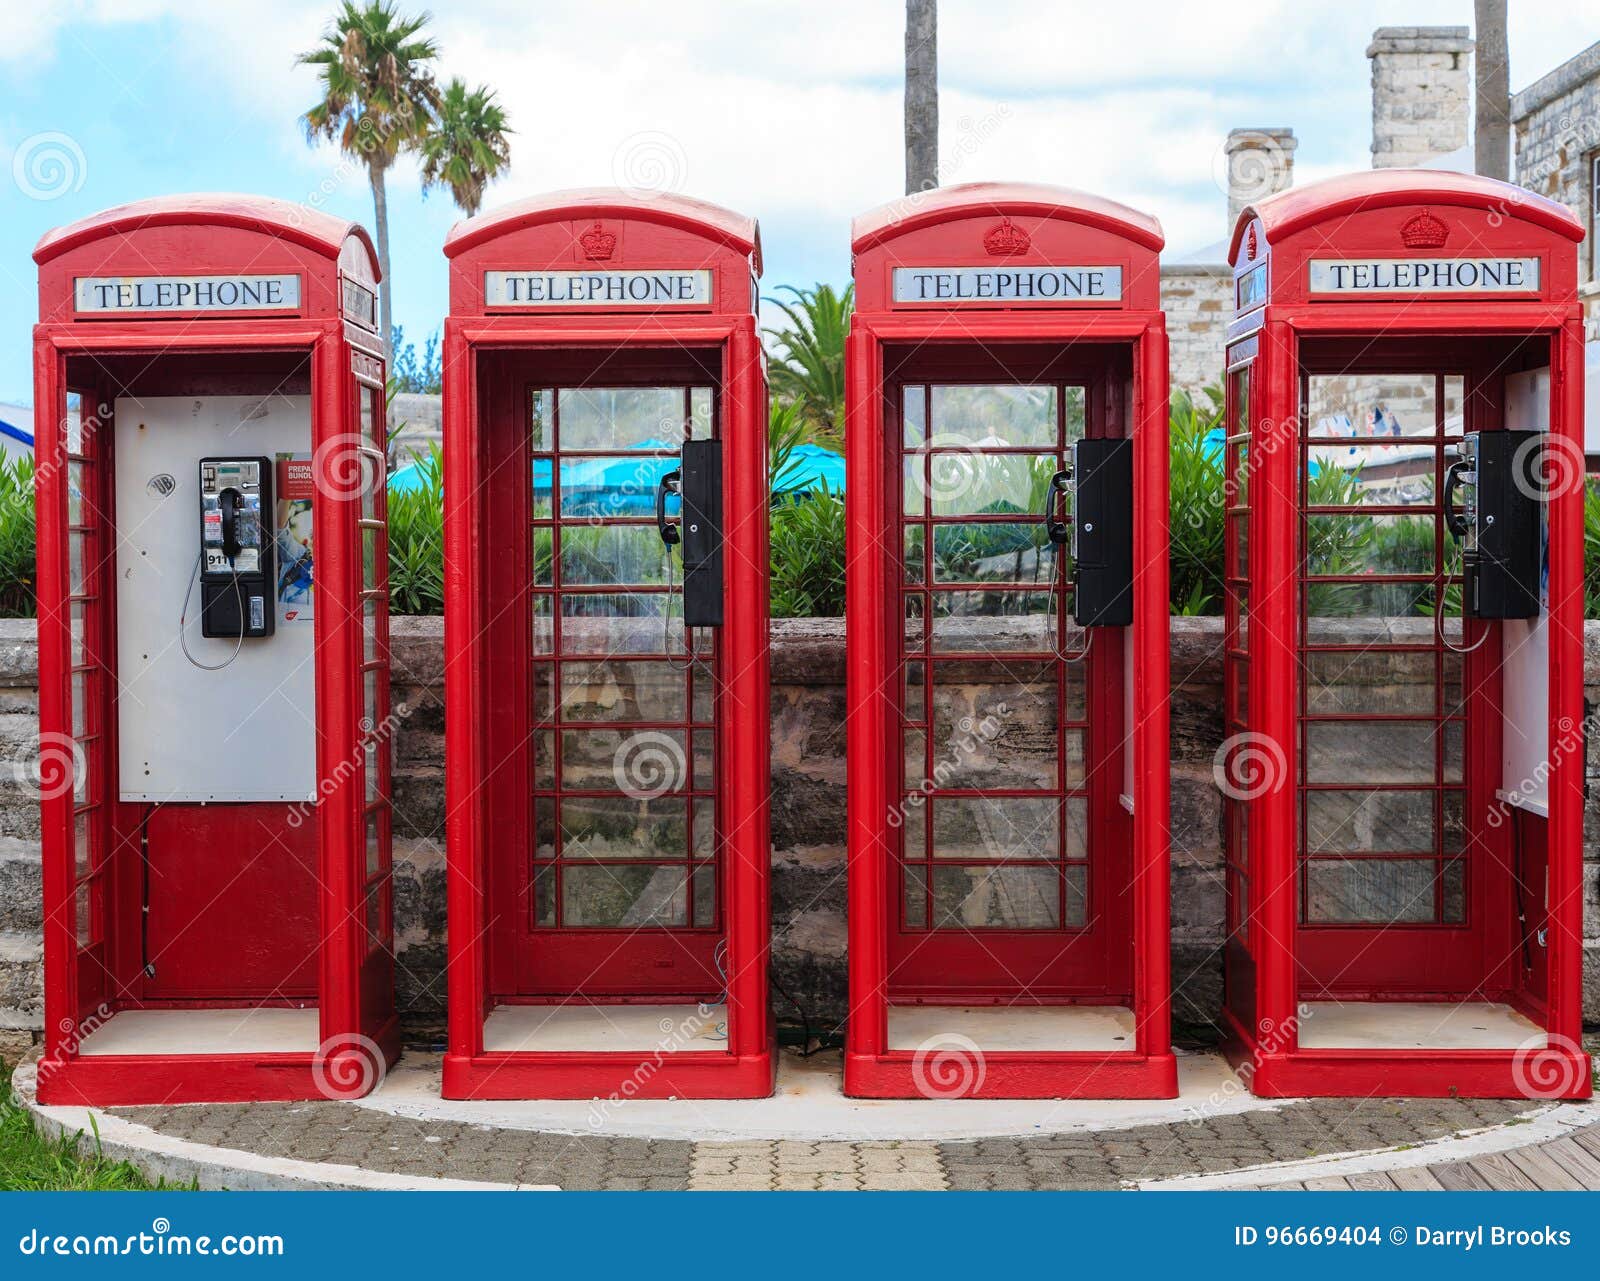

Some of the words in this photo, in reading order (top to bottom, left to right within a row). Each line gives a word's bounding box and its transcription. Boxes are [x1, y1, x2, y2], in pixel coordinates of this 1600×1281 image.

[913, 272, 1105, 298] TELEPHONE
[1330, 262, 1524, 289] TELEPHONE
[94, 280, 284, 308] TELEPHONE
[505, 276, 695, 301] TELEPHONE
[288, 465, 312, 473] PREPA
[208, 554, 228, 565] 911
